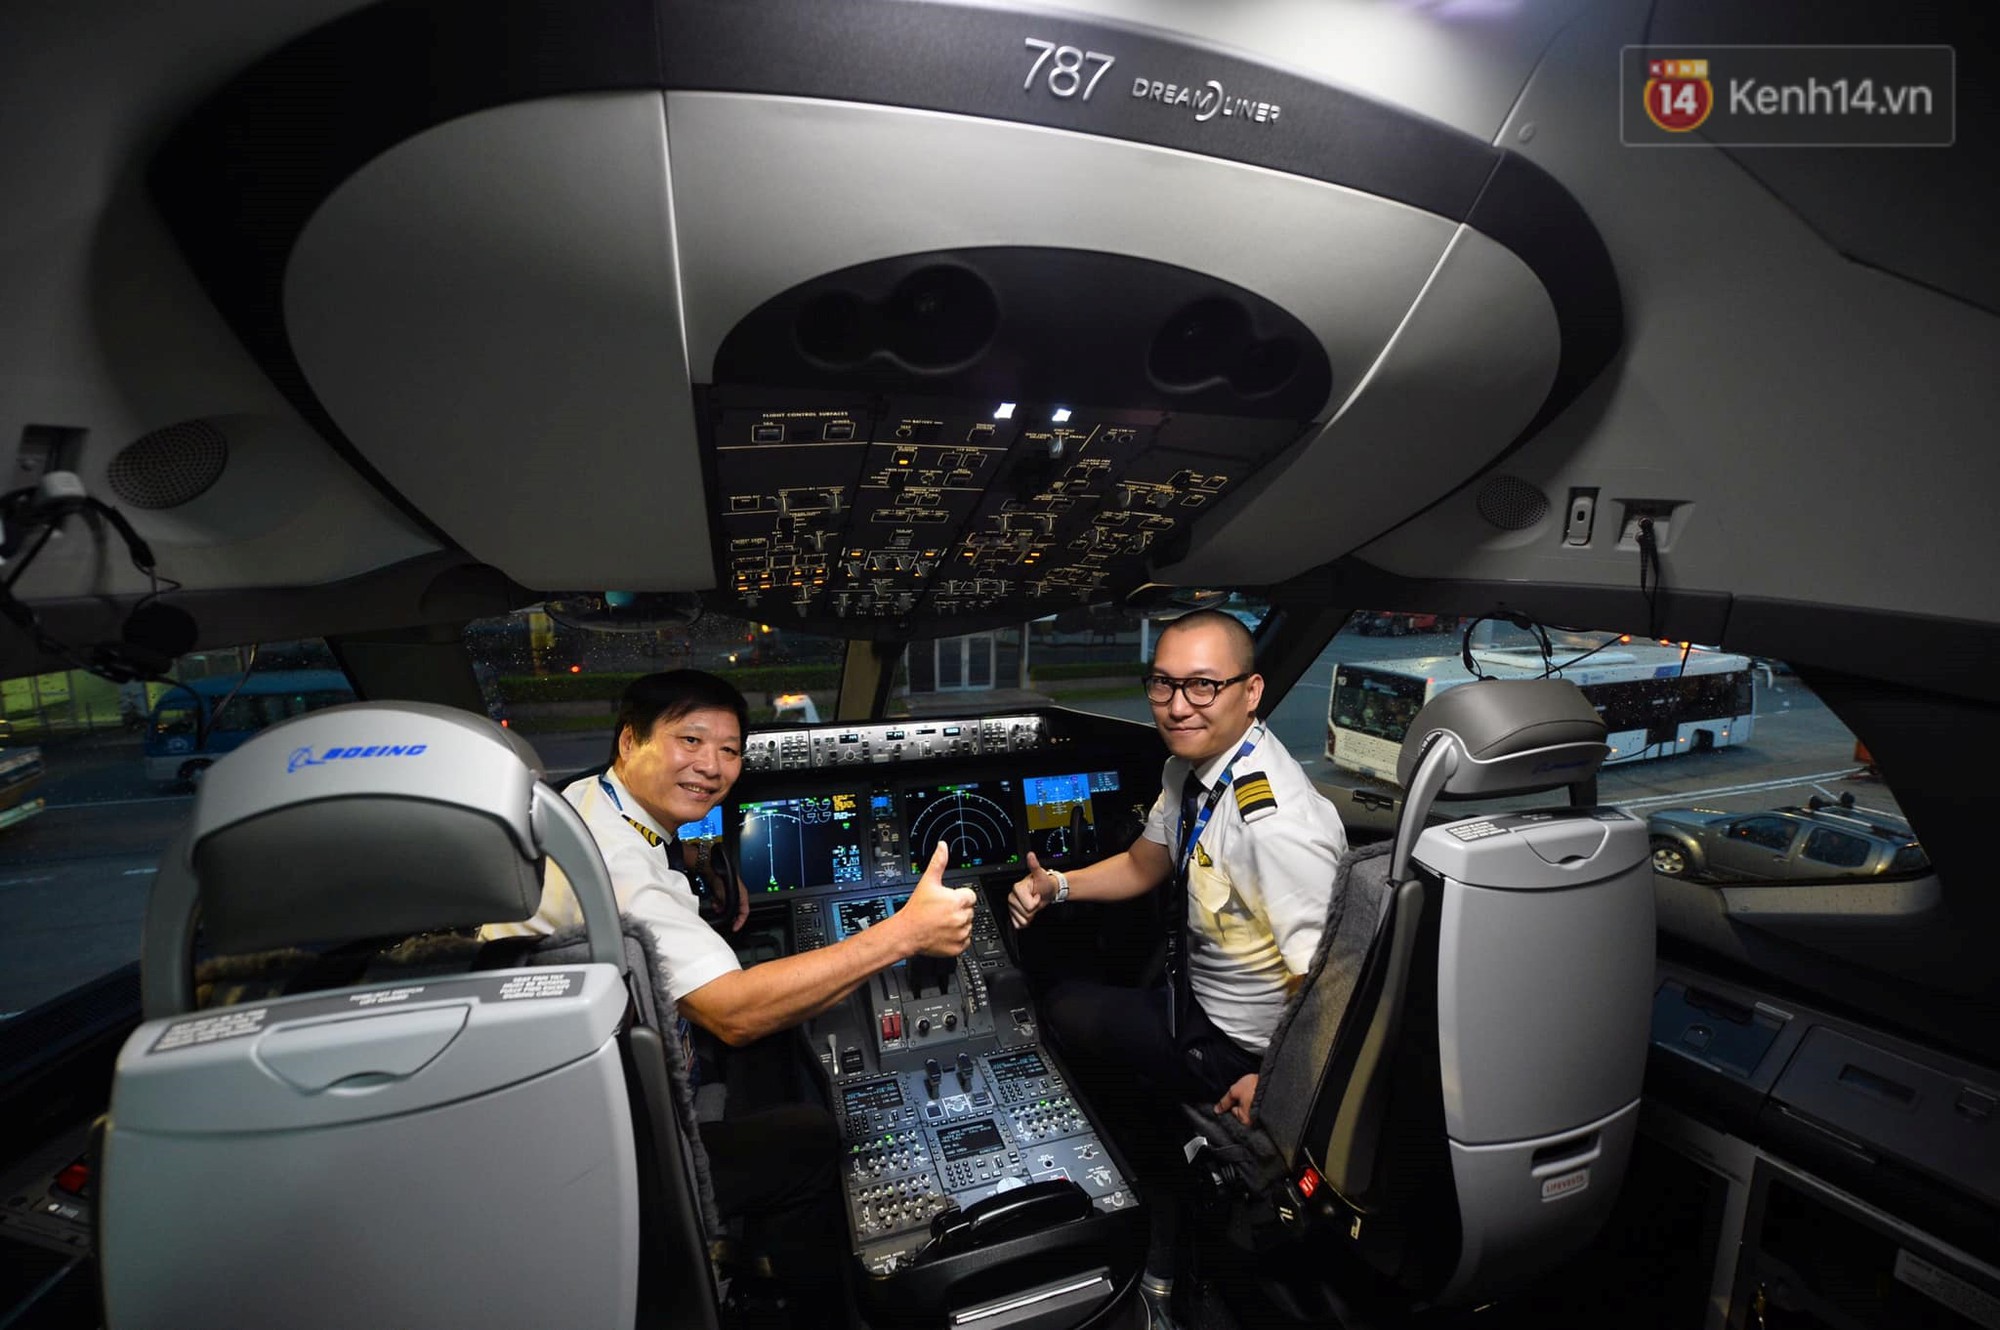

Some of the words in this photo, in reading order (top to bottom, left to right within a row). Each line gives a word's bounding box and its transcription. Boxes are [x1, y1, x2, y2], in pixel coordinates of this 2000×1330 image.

[1024, 37, 1116, 101] 787
[1132, 77, 1281, 123] DREAMLINER
[322, 744, 428, 760] BOEING
